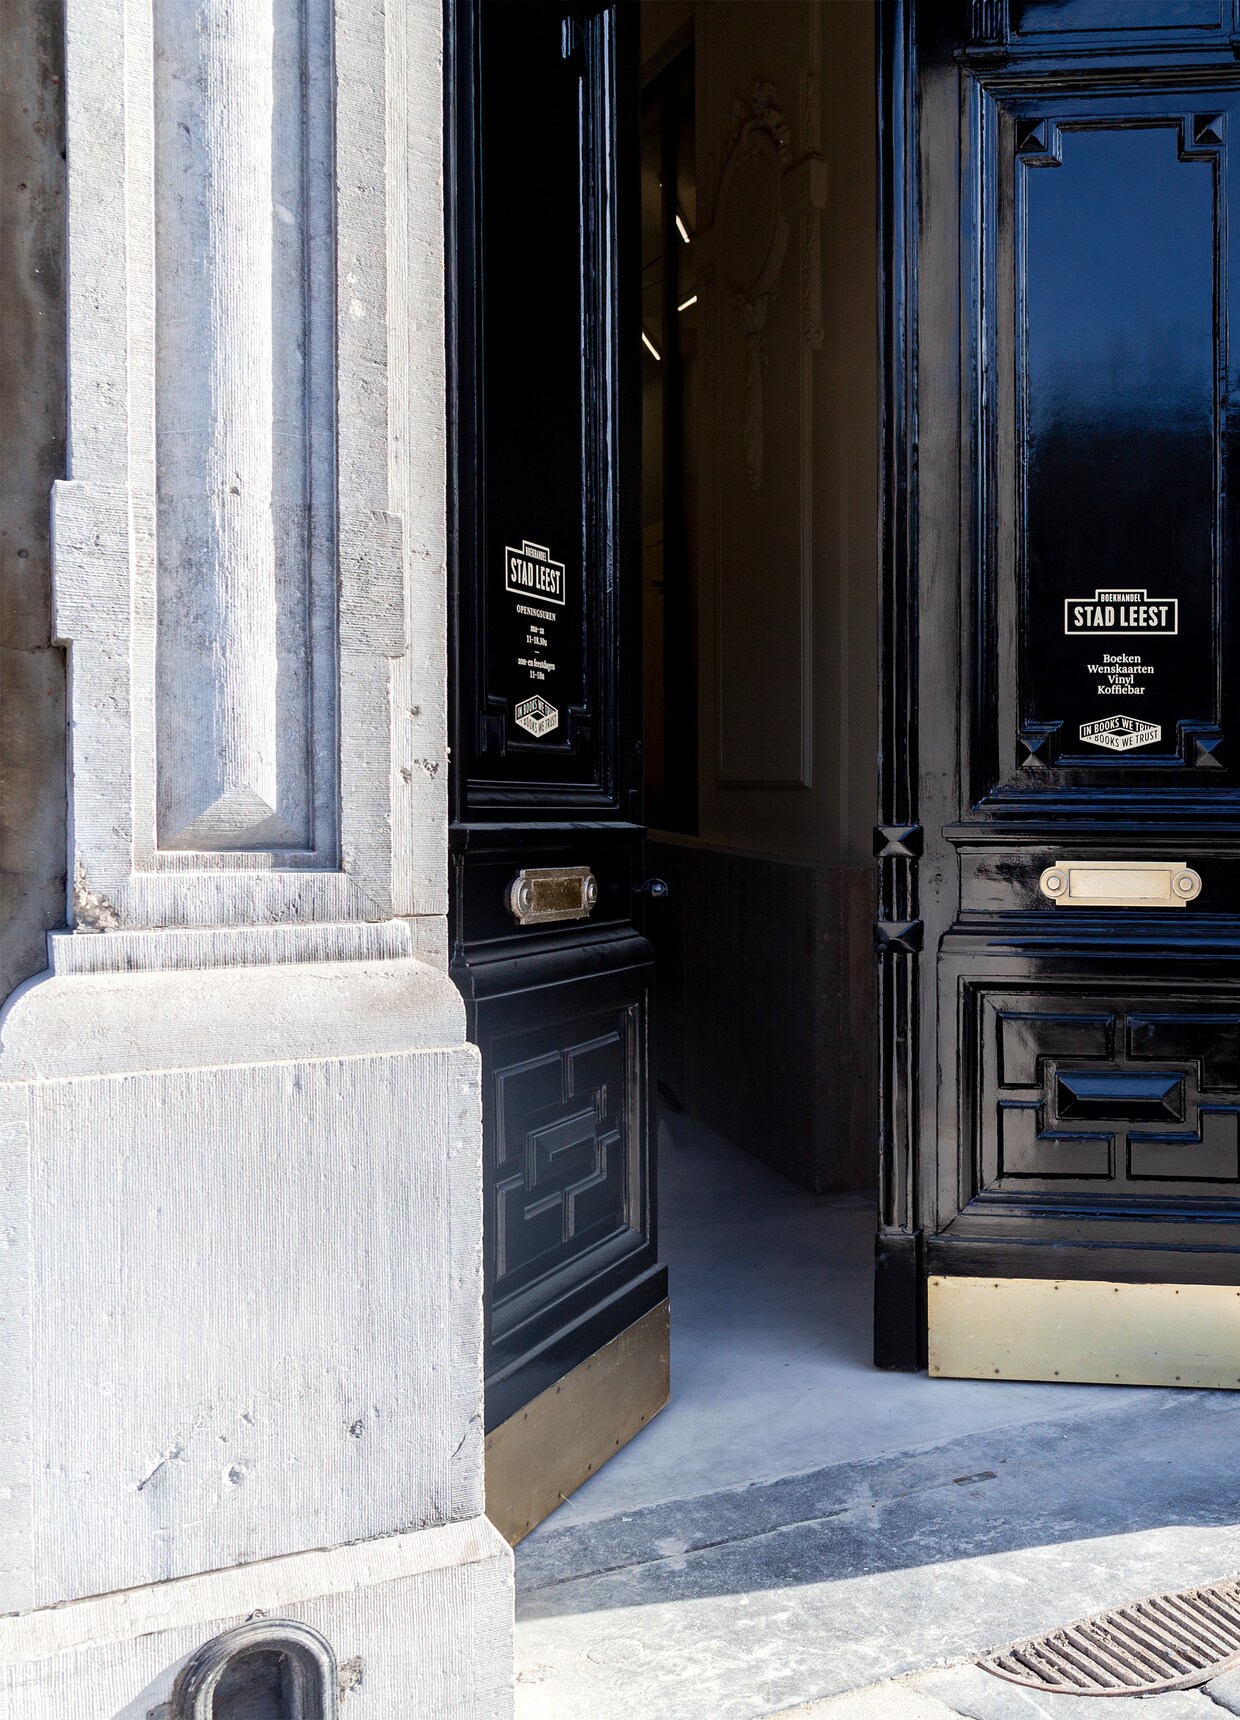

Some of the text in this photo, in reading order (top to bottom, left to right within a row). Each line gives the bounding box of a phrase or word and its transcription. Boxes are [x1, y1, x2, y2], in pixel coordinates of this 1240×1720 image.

[525, 546, 547, 562] BOEKHANDEL
[510, 557, 560, 594] STAD LEEST
[1100, 593, 1141, 602] BOEKHANDEL
[516, 604, 556, 621] OPENINGSUREN
[1074, 606, 1169, 627] STAD LEEST
[1103, 653, 1141, 663] Boeken
[1087, 664, 1154, 674] Wenskaarten
[1108, 674, 1134, 686] Vinyl
[1097, 684, 1145, 695] Koffiebar
[1083, 718, 1156, 736] IN BOOKS WE TRU
[1121, 736, 1133, 748] WE
[1136, 730, 1158, 744] TRUST
